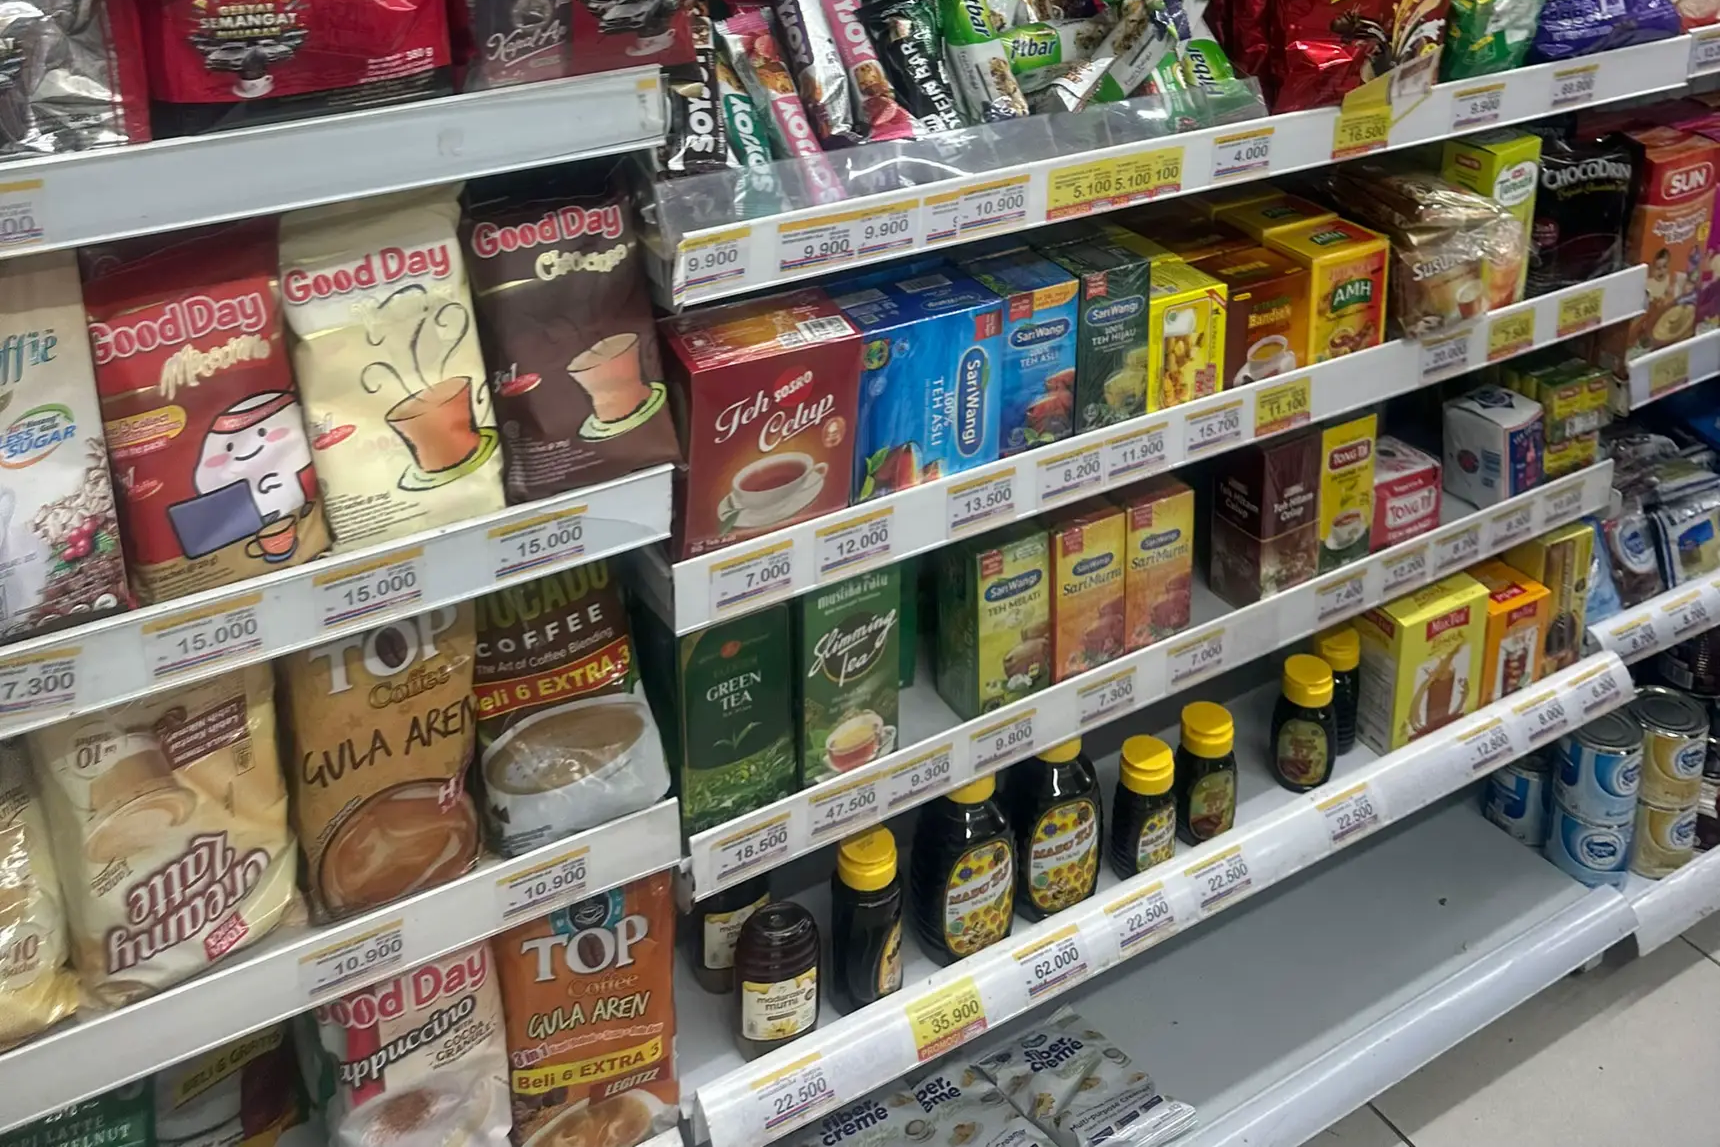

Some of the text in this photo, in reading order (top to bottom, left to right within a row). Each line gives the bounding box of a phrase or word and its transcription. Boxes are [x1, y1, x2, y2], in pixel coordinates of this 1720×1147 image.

[199, 12, 299, 30] SEMANGAT
[780, 95, 843, 205] SOYJOY
[1236, 142, 1269, 161] 4.000
[1073, 173, 1151, 199] 5.100 5.100
[1156, 164, 1179, 181] 100
[1670, 167, 1707, 193] SUN
[976, 194, 1025, 216] 10.900
[472, 203, 623, 259] Good Day
[864, 219, 909, 240] 9.900
[688, 248, 738, 272] 9.900
[803, 238, 850, 260] 9.900
[283, 242, 451, 306] Good Day
[1333, 279, 1373, 306] AMH
[90, 302, 184, 367] Good
[184, 292, 268, 338] Day
[714, 390, 771, 444] Teh
[930, 377, 944, 447] TEH ASLI
[965, 358, 982, 447] SariWangi
[6, 423, 77, 458] SUGAR
[1198, 417, 1240, 441] 15.700
[1121, 439, 1165, 465] 11.900
[1063, 459, 1102, 483] 8.200
[964, 487, 1013, 515] 13.500
[515, 526, 584, 558] 15.000
[836, 528, 890, 557] 12.000
[342, 571, 418, 607] 15.000
[745, 561, 792, 589] 7.000
[176, 618, 259, 655] 15.000
[476, 602, 604, 658] COFFEE
[807, 608, 898, 678] Slimming
[310, 604, 459, 696] TOP
[529, 646, 567, 669] Coffee
[568, 626, 616, 655] Blending
[1191, 642, 1224, 665] 7.000
[368, 663, 454, 710] Coffee
[479, 688, 510, 713] eli
[515, 683, 532, 701] 6
[536, 654, 618, 697] EXTRA
[705, 669, 763, 702] GREEN
[1099, 682, 1134, 707] 7.300
[719, 689, 754, 712] TEA
[995, 724, 1033, 751] 9.800
[1476, 732, 1509, 759] 12.800
[300, 728, 394, 790] GULA
[910, 760, 951, 788] 9.300
[825, 791, 877, 820] 47.500
[1336, 803, 1374, 831] 22.500
[734, 830, 789, 864] 18.500
[125, 830, 236, 926] Latte
[524, 865, 588, 900] 10.900
[1207, 861, 1249, 892] 22.500
[106, 848, 271, 976] Creamy
[1126, 900, 1170, 932] 22.500
[332, 936, 404, 977] 10.900
[520, 913, 650, 984] TOP
[1034, 946, 1081, 981] 62.000
[413, 944, 489, 1008] Day
[567, 971, 640, 1000] Coffee
[527, 1002, 586, 1041] GULA
[590, 991, 651, 1021] AREN
[931, 1000, 981, 1035] 35.900
[443, 1020, 485, 1050] COCOA
[517, 1042, 661, 1092] Beli 6 EXTRA 3
[774, 1078, 828, 1117] 22.500
